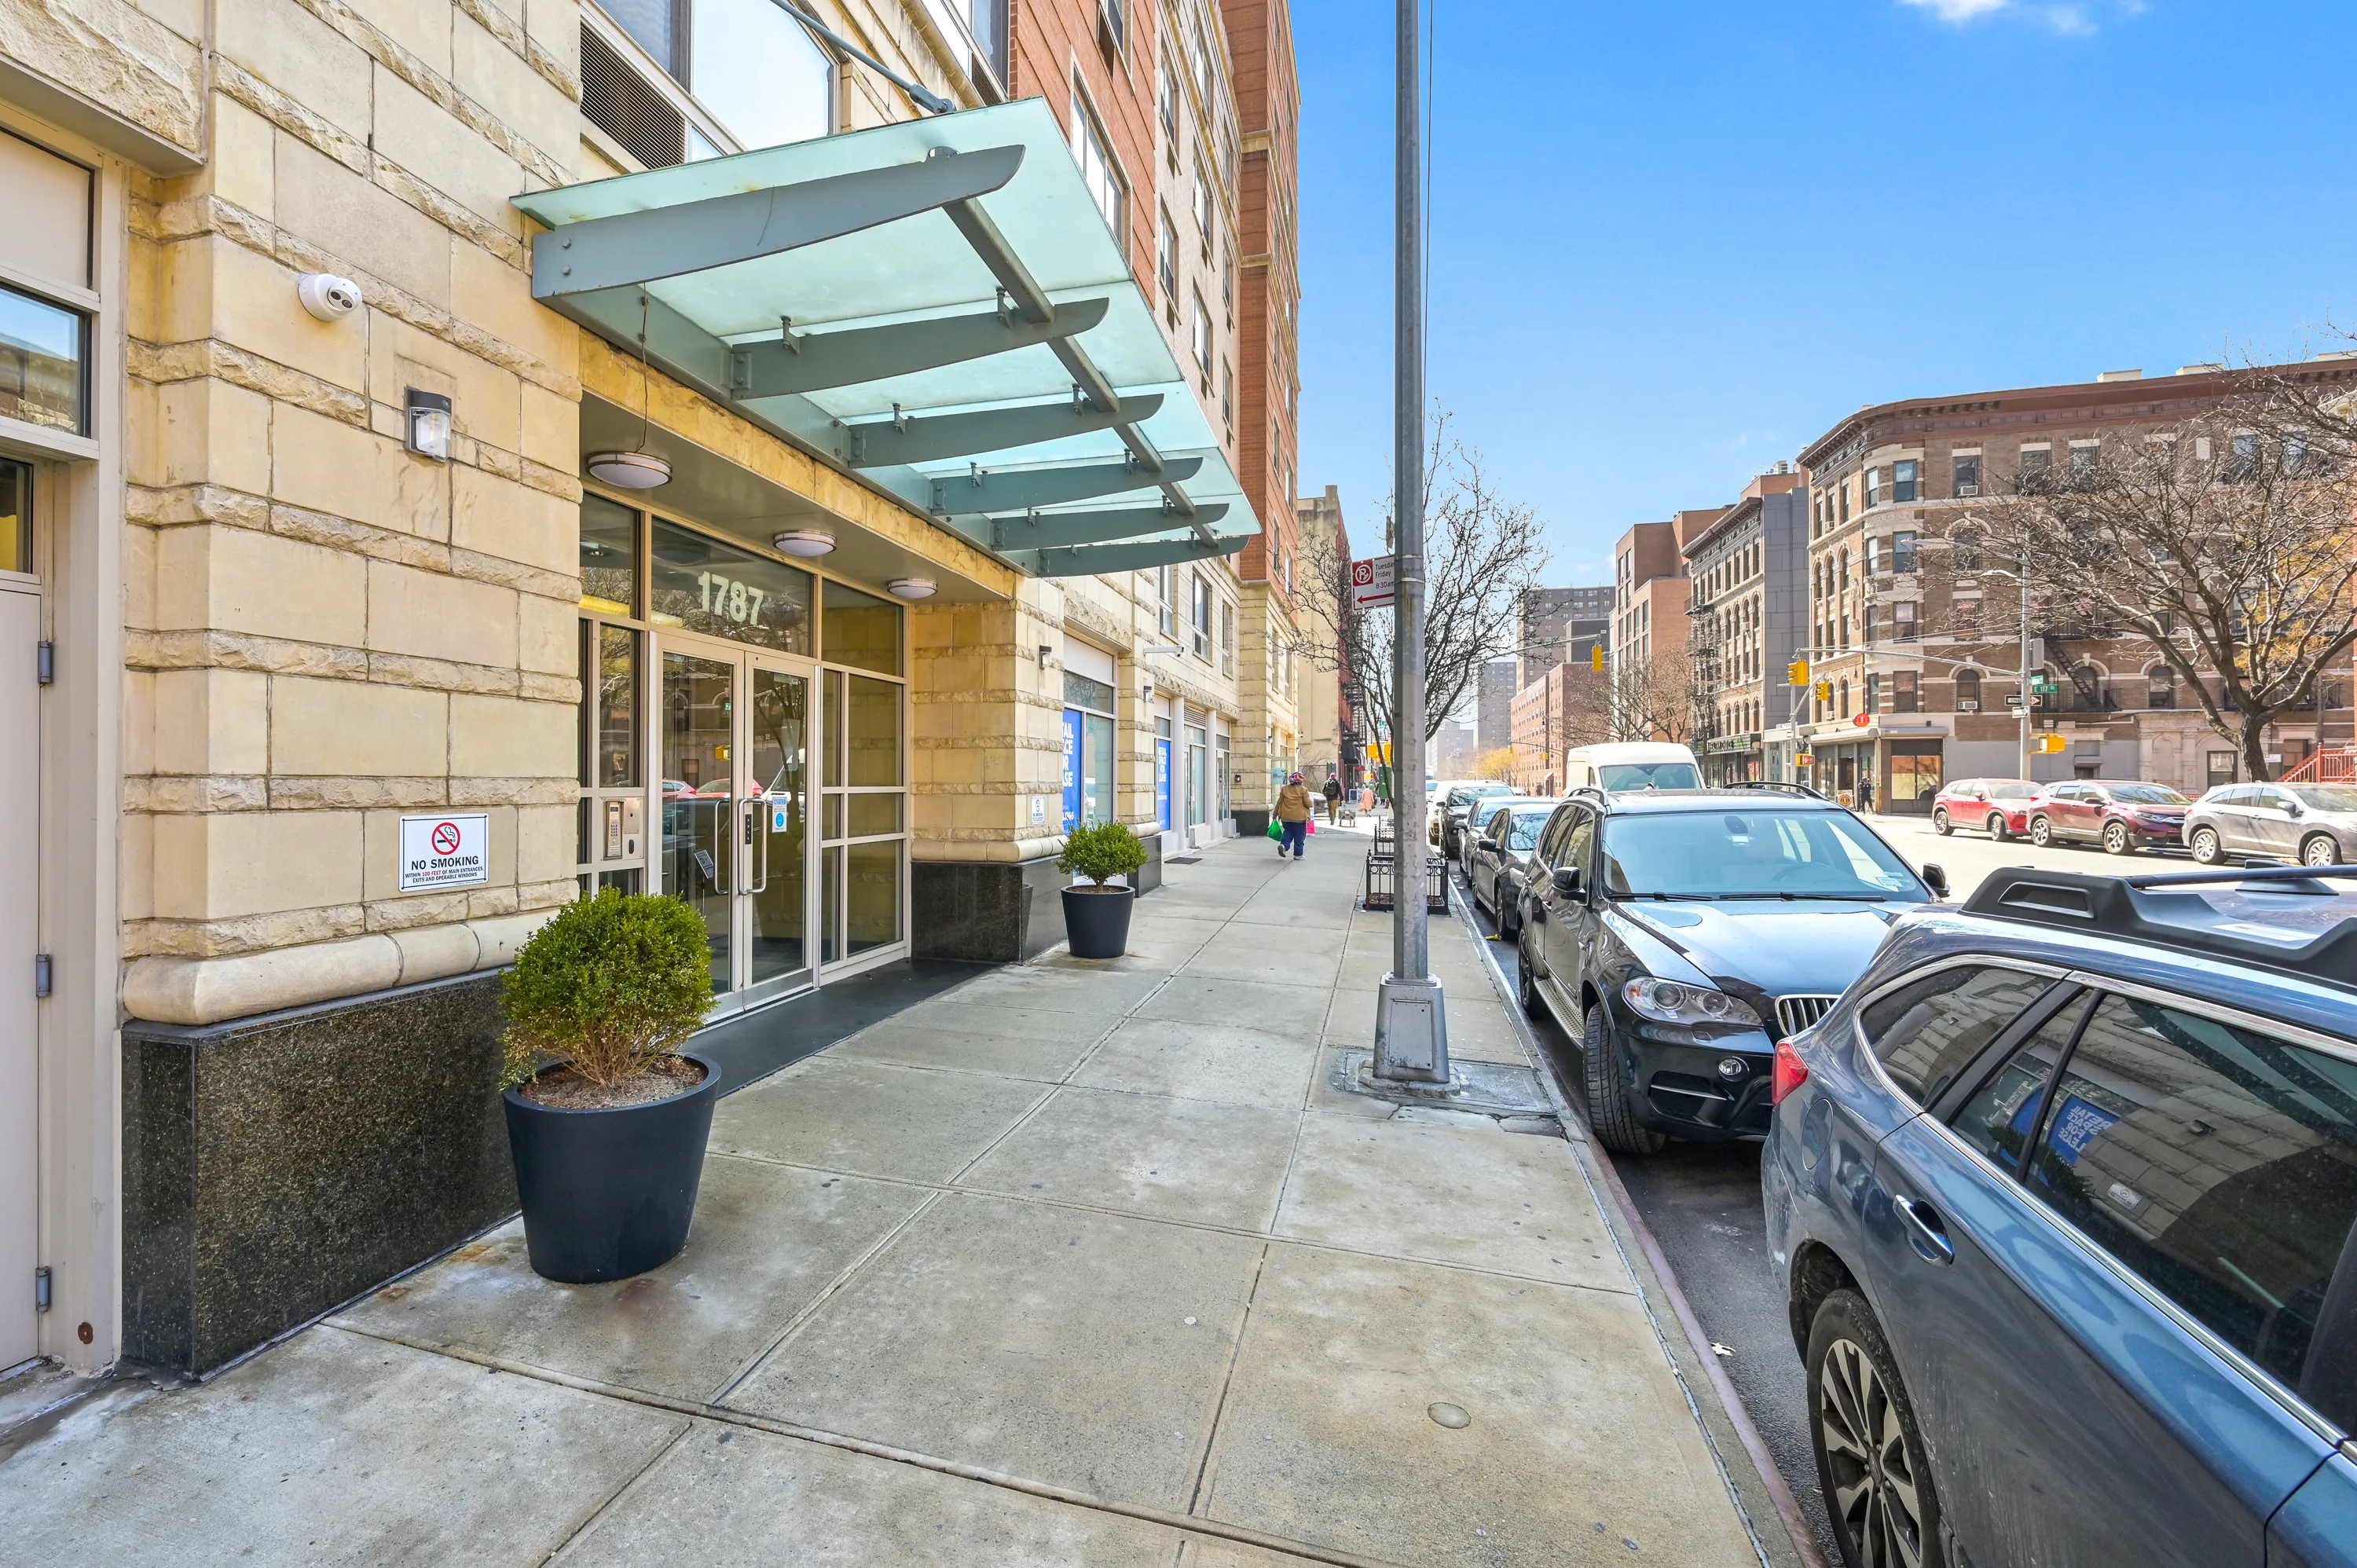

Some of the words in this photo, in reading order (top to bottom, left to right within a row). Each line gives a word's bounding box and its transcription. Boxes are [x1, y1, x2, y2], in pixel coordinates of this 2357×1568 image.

[698, 570, 764, 626] 1787
[412, 860, 427, 870] NO
[431, 855, 478, 868] SMOKING
